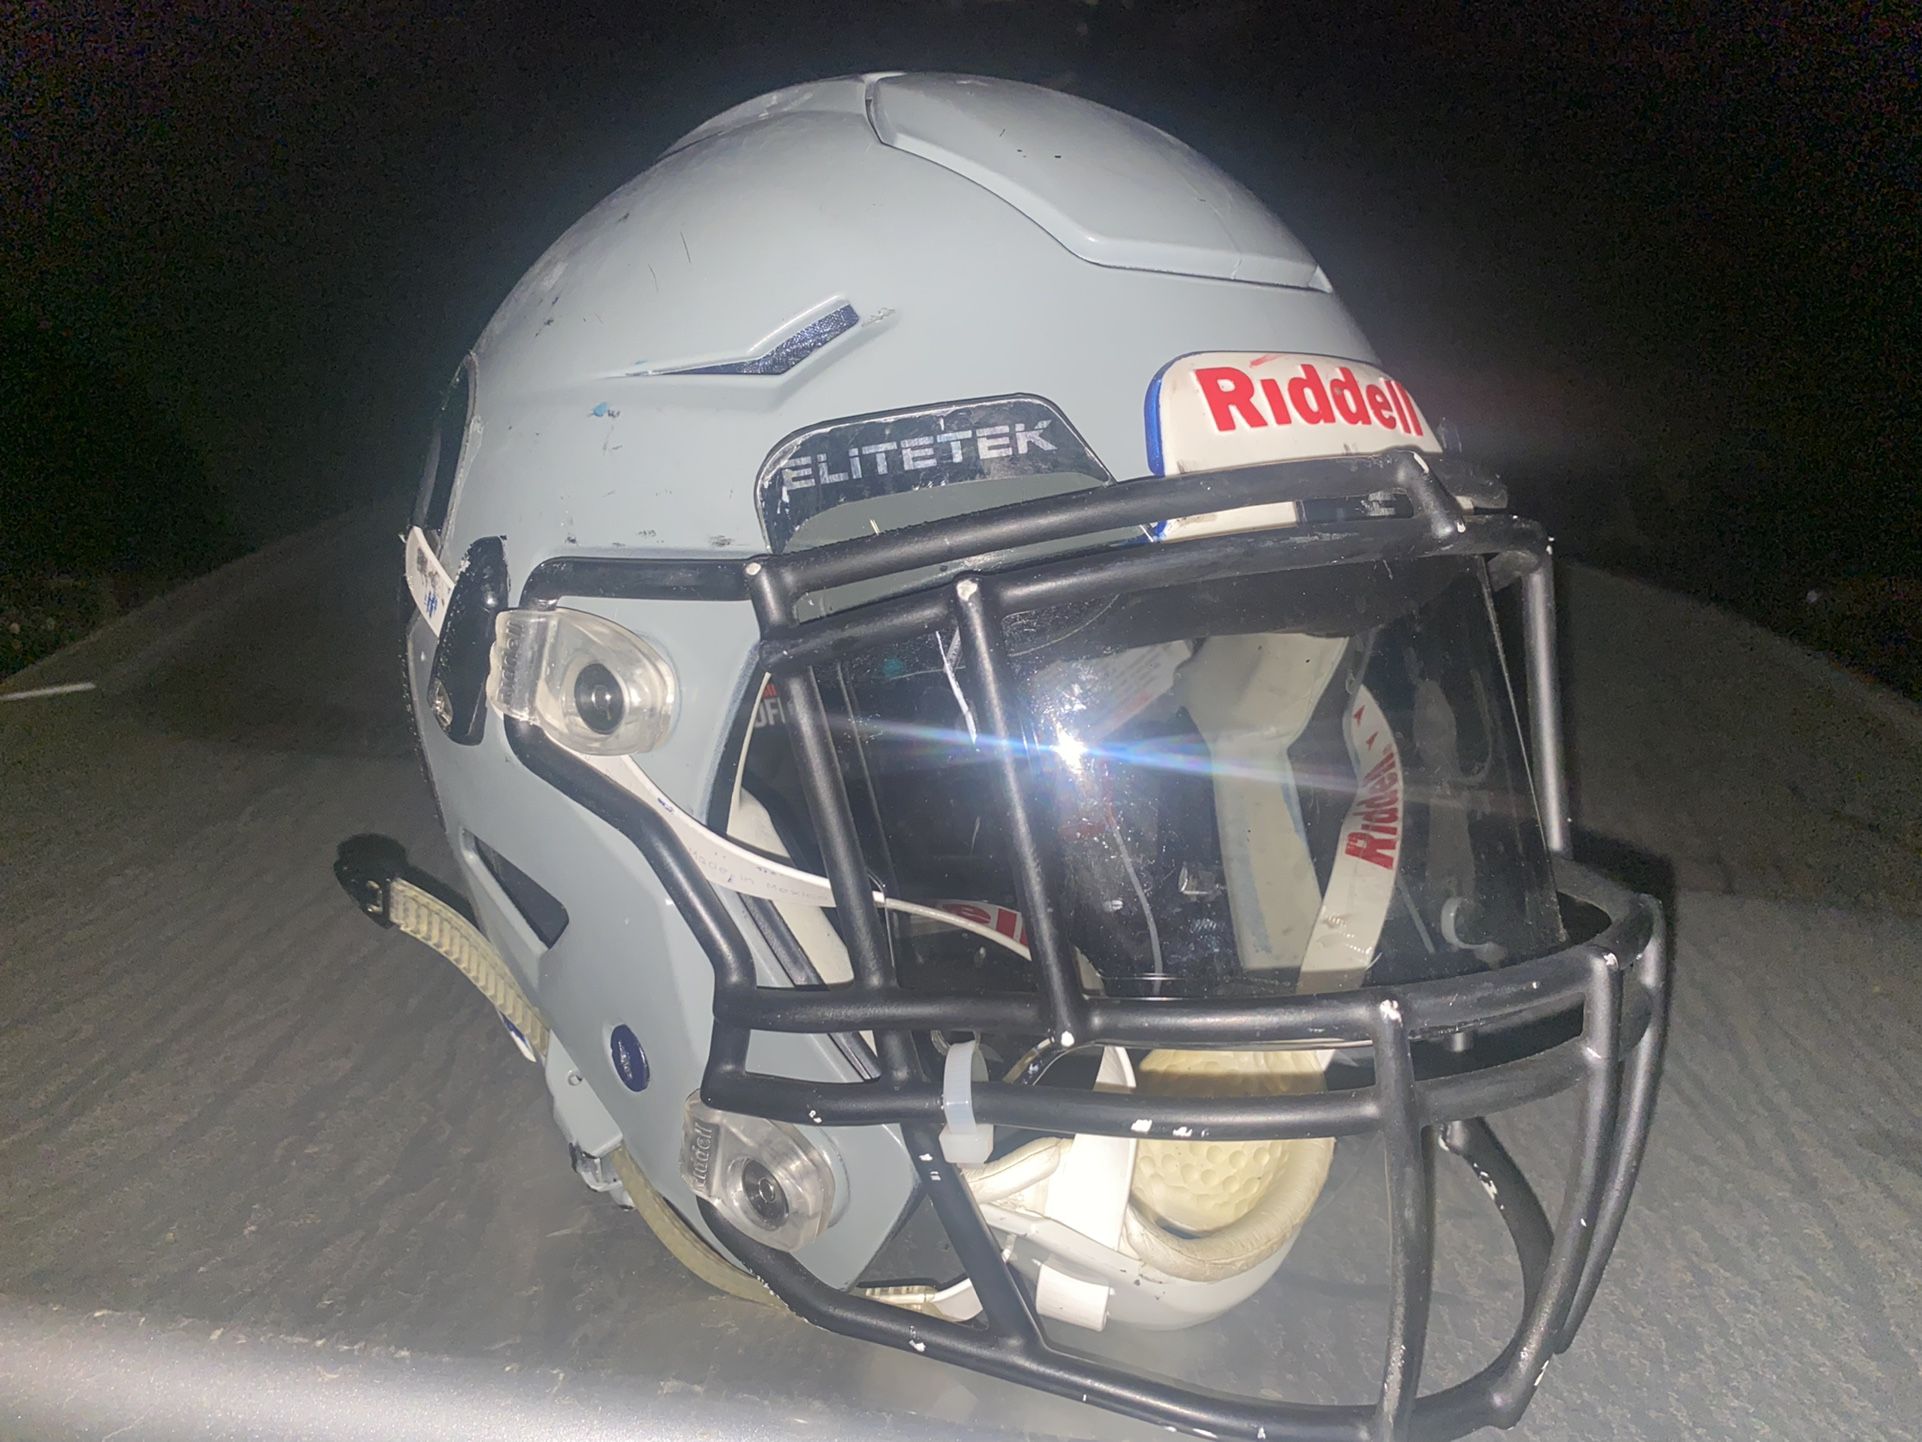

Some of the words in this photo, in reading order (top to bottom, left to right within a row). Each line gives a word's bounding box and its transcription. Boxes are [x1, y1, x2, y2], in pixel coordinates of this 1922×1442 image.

[1194, 364, 1424, 436] Riddell
[781, 420, 1058, 490] ELITETEK
[1345, 750, 1399, 870] Riddell
